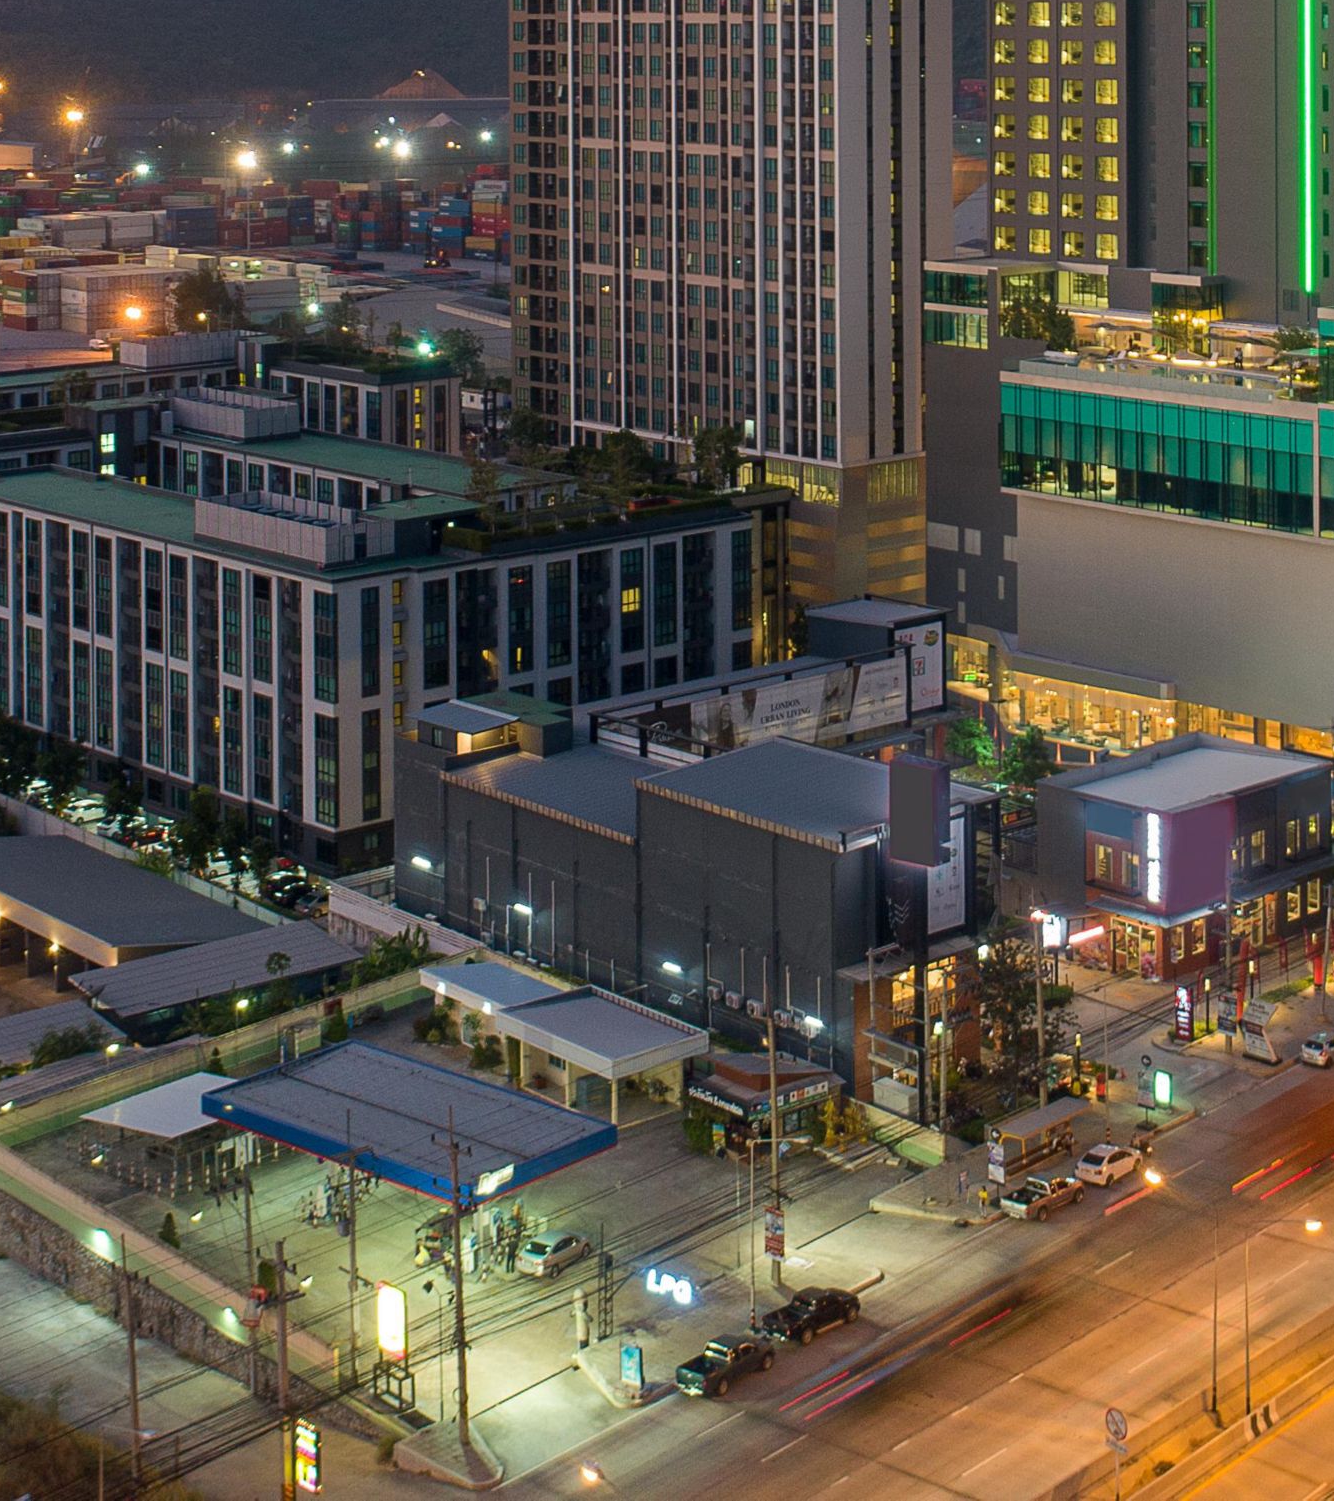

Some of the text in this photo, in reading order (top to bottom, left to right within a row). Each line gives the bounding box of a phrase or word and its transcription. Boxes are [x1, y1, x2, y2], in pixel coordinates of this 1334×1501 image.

[770, 698, 801, 712] LONDON
[760, 712, 785, 725] URBAN
[787, 707, 811, 719] LIVING
